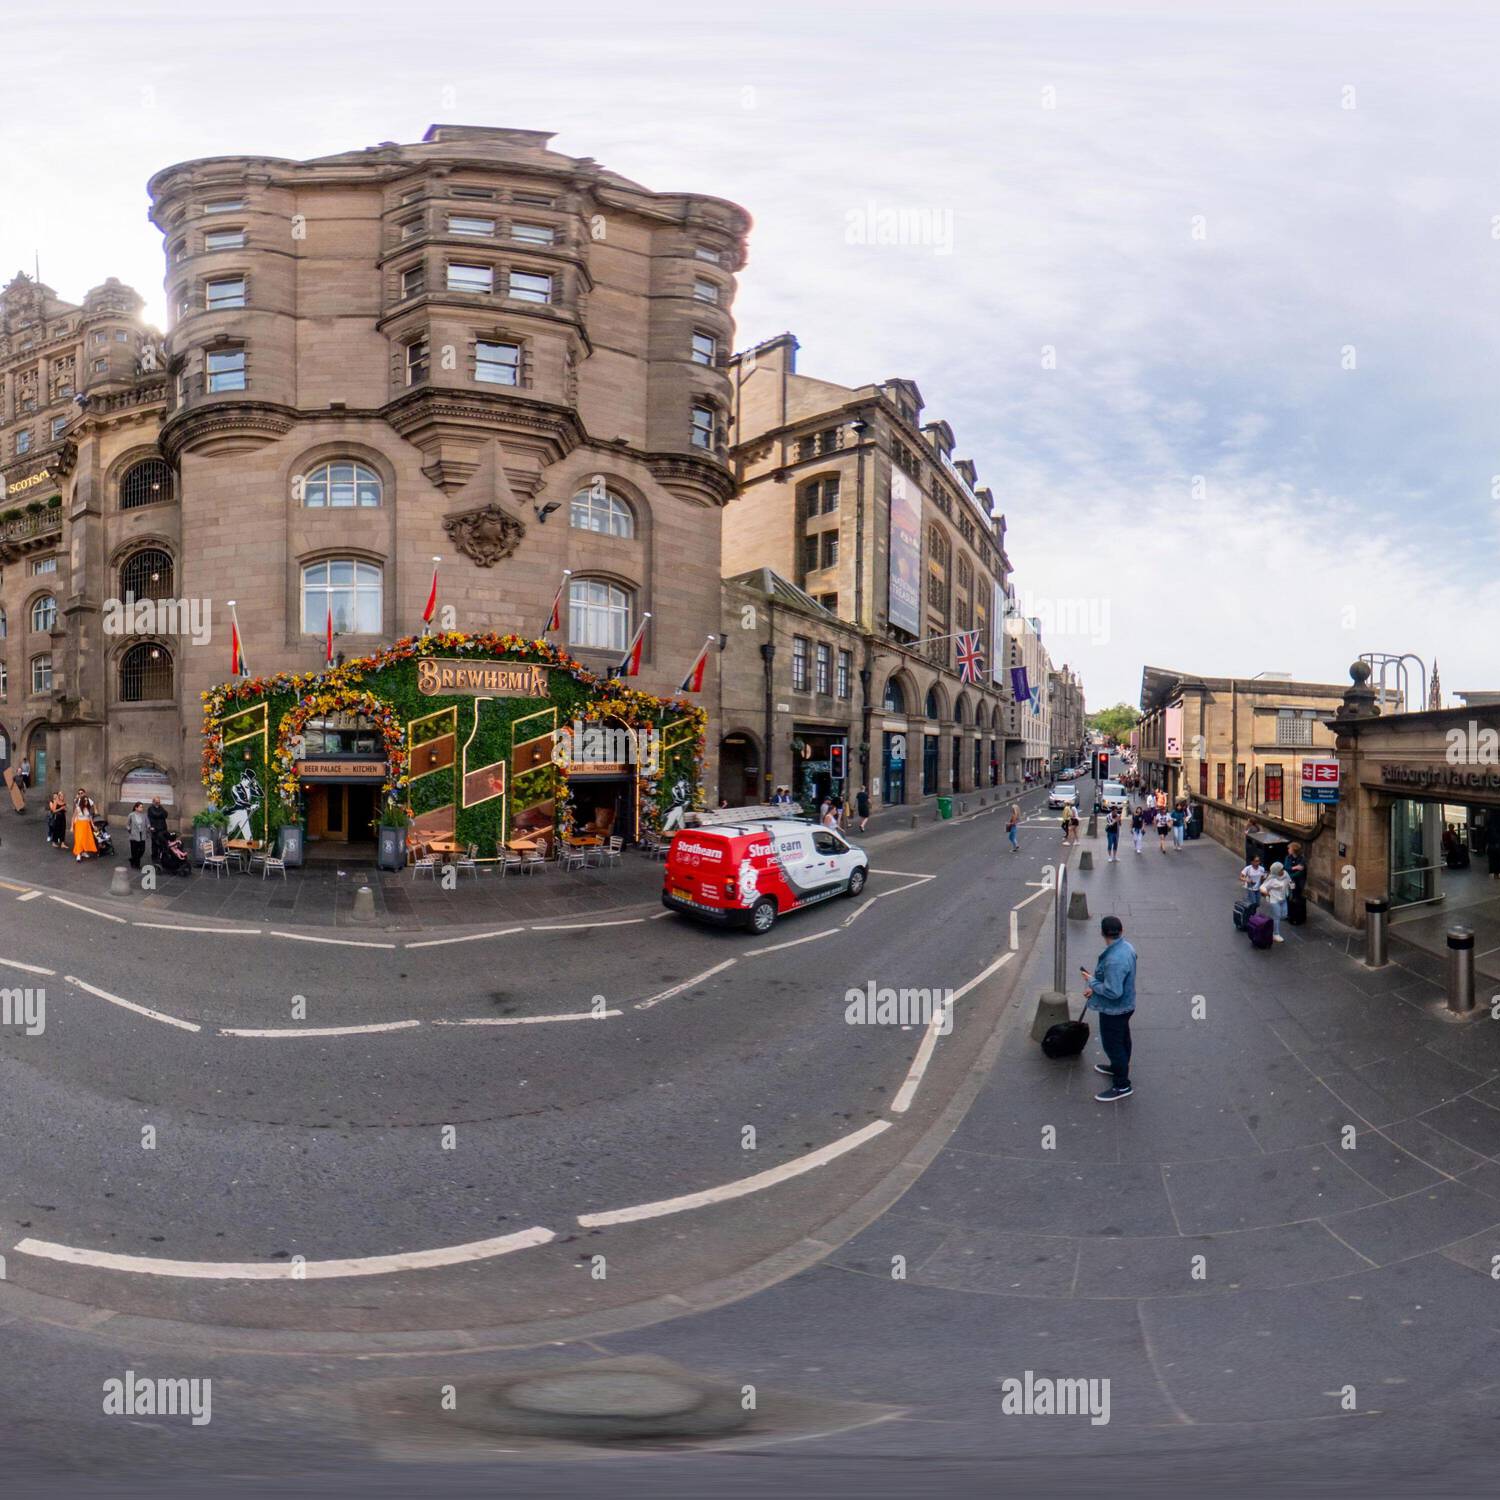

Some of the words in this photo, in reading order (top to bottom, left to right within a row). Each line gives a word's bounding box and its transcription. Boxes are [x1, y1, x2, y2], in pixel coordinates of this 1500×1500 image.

[9, 470, 50, 493] SCOTSM
[418, 660, 551, 698] BREWHEMIA
[304, 765, 318, 773] BEER
[320, 765, 341, 773] PALACE
[352, 765, 377, 773] KITCHEN
[1382, 765, 1437, 786] Edinburgh
[677, 841, 722, 858] Strathearn
